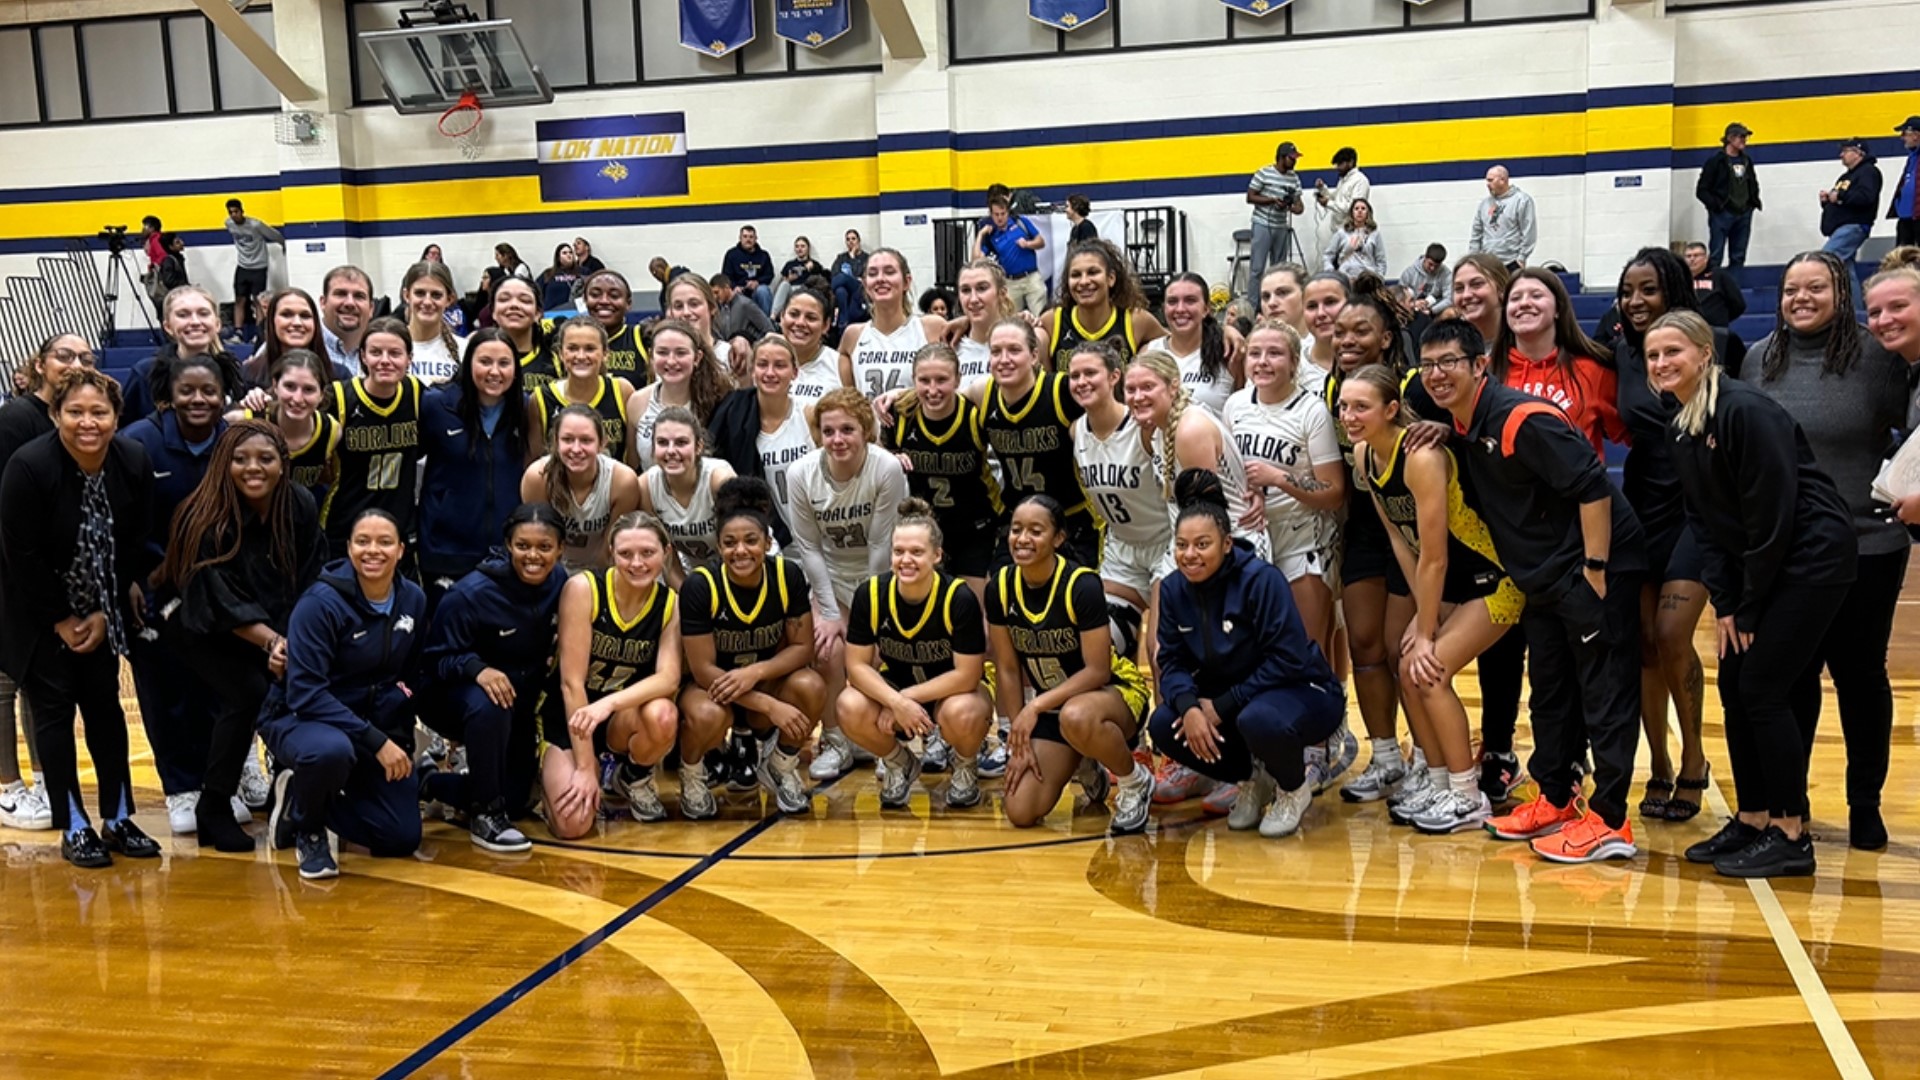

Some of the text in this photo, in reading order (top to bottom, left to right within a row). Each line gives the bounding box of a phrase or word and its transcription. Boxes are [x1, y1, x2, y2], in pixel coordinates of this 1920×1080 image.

[551, 135, 677, 161] LOK NATION
[408, 361, 458, 377] NTLESS
[1515, 382, 1573, 410] ERSON
[1235, 433, 1302, 467] ORLOKS
[366, 452, 403, 490] 10
[1005, 457, 1045, 492] 14
[1081, 463, 1141, 489] ORLOKS
[927, 476, 955, 508] 2
[1097, 493, 1132, 524] 13
